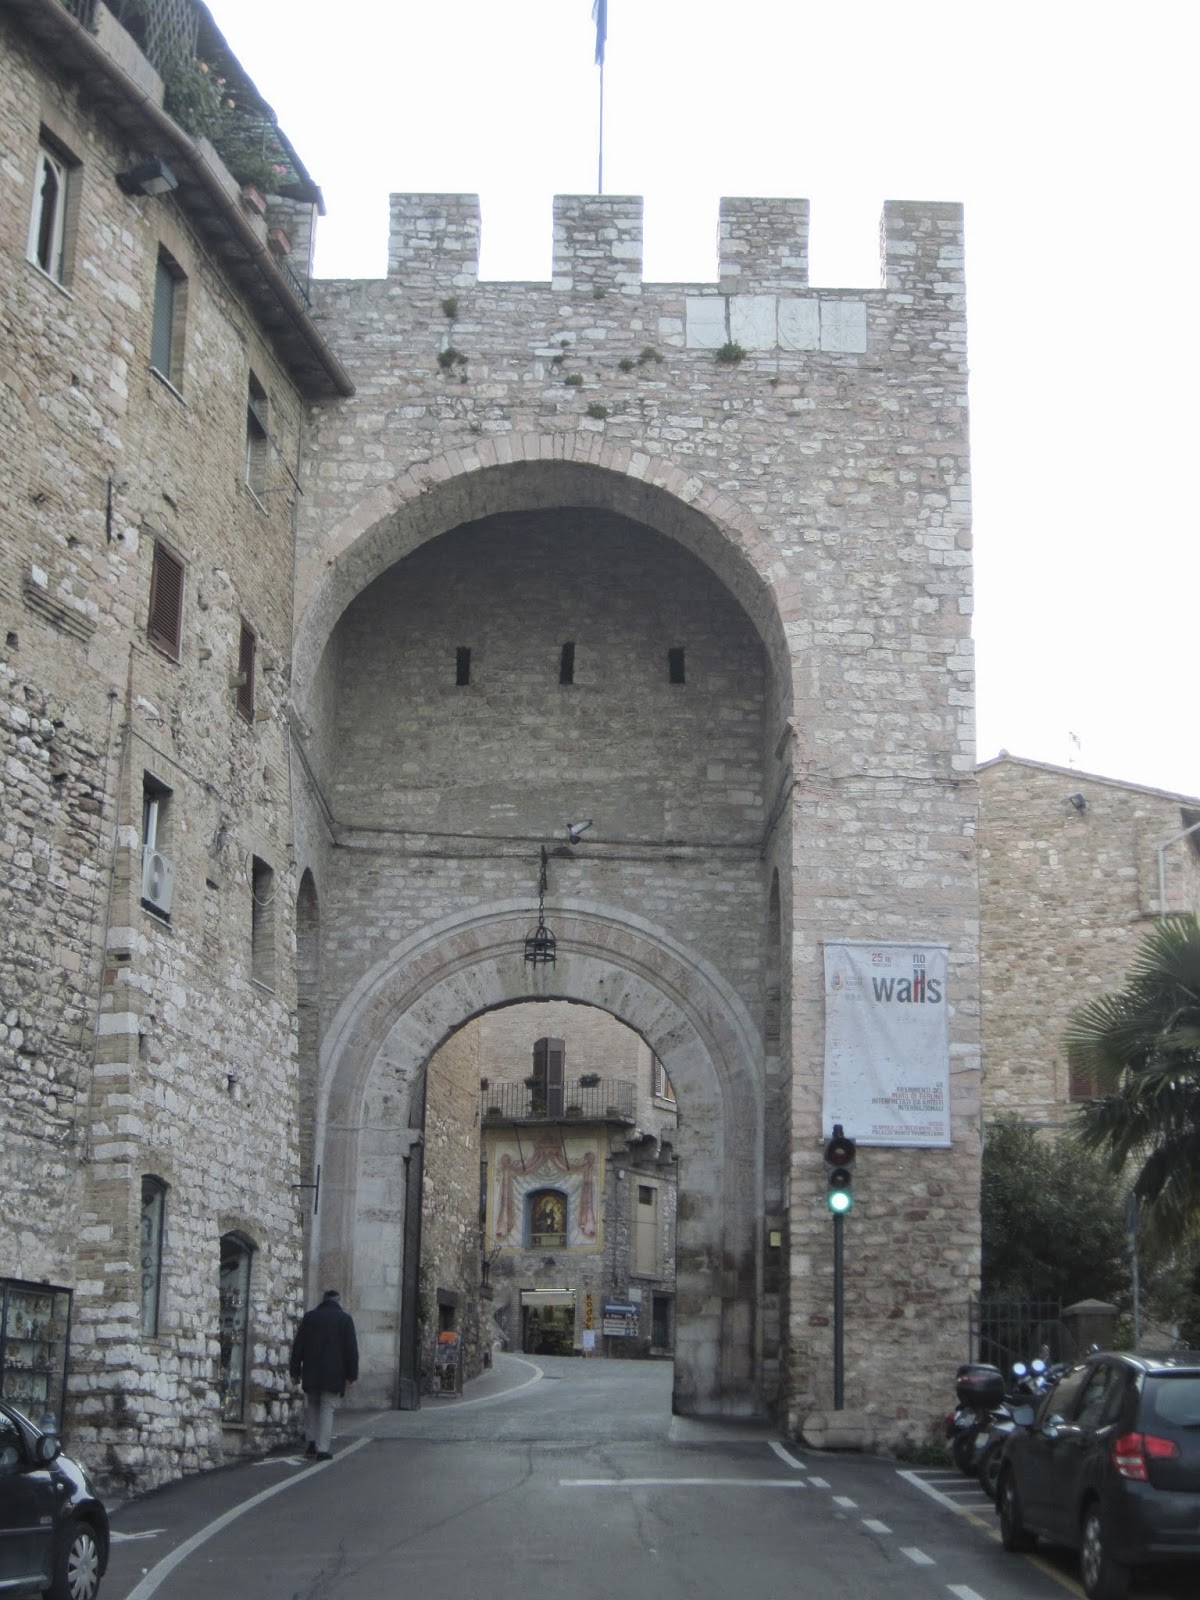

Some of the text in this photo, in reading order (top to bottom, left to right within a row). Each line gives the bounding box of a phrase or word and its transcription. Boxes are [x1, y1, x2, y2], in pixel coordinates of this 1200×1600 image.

[872, 953, 883, 963] 25
[913, 954, 926, 964] no
[872, 969, 942, 1004] walls
